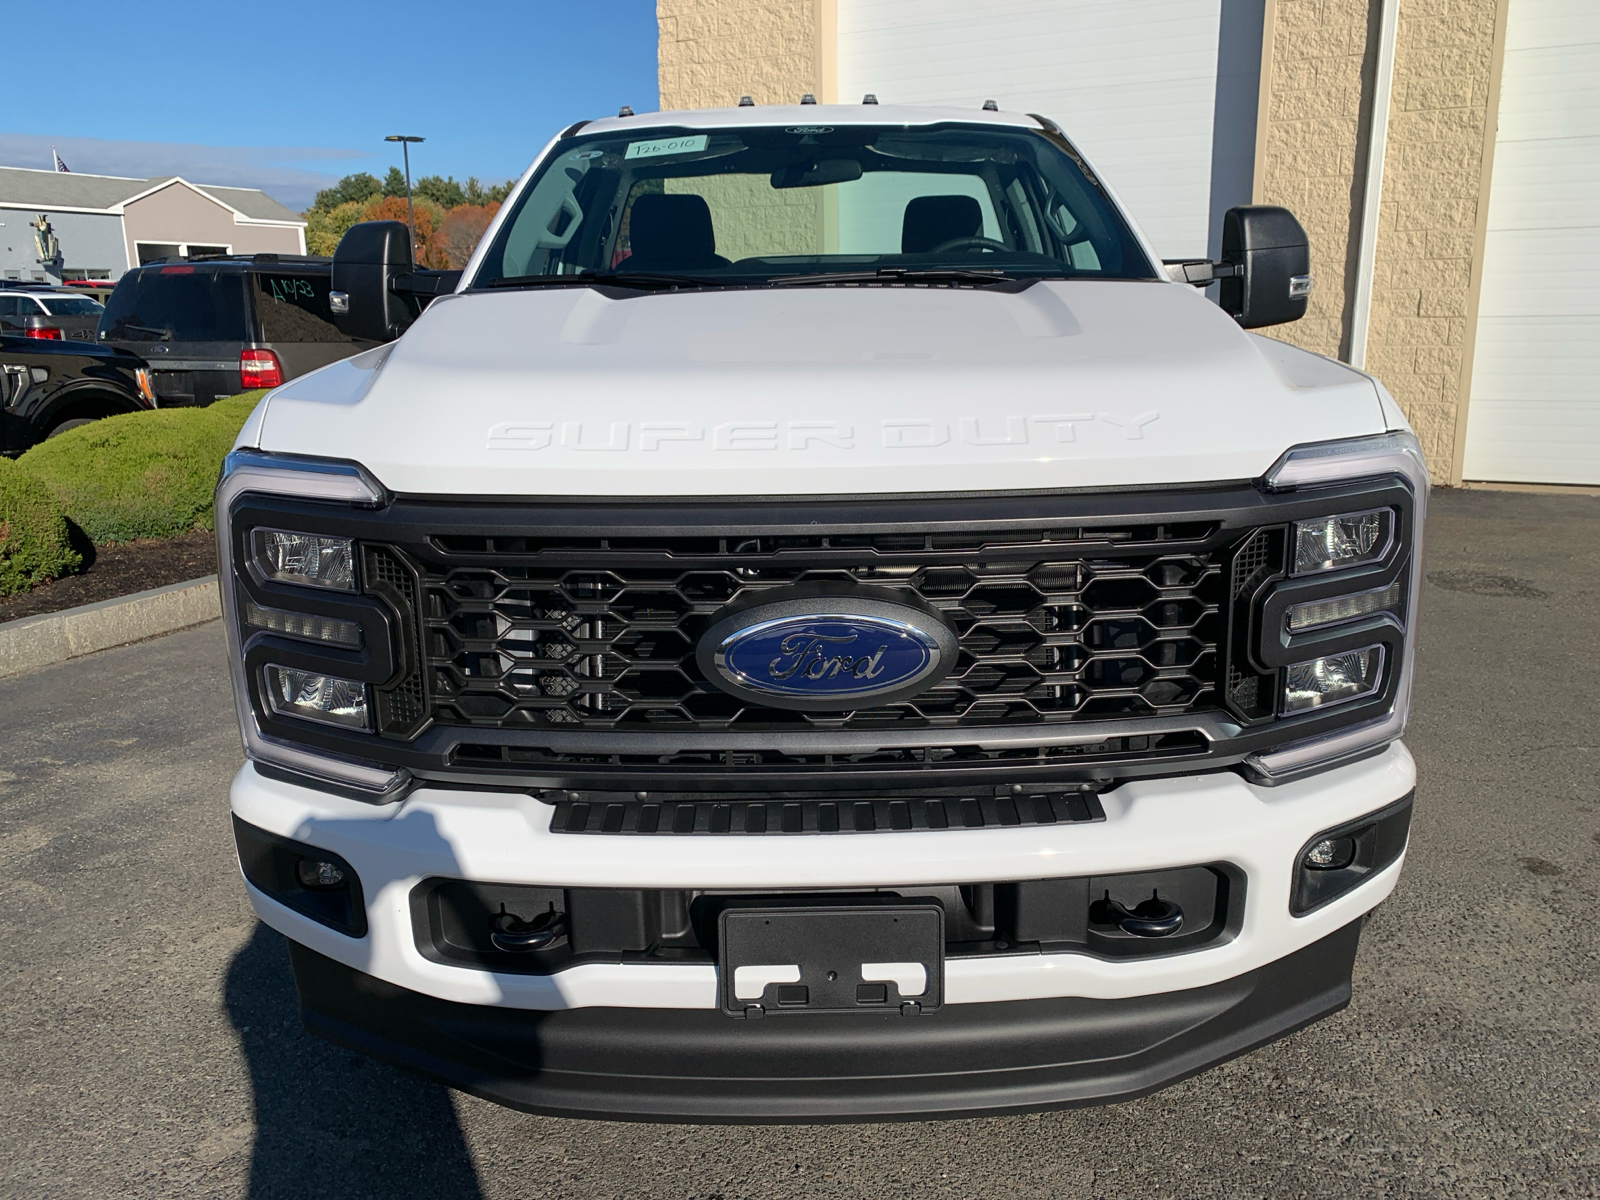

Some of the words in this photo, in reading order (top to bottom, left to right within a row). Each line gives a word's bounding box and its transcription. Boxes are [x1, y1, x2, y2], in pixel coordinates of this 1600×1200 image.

[486, 420, 854, 451] SUPER
[880, 410, 1160, 448] DUTY
[768, 633, 888, 681] Ford
